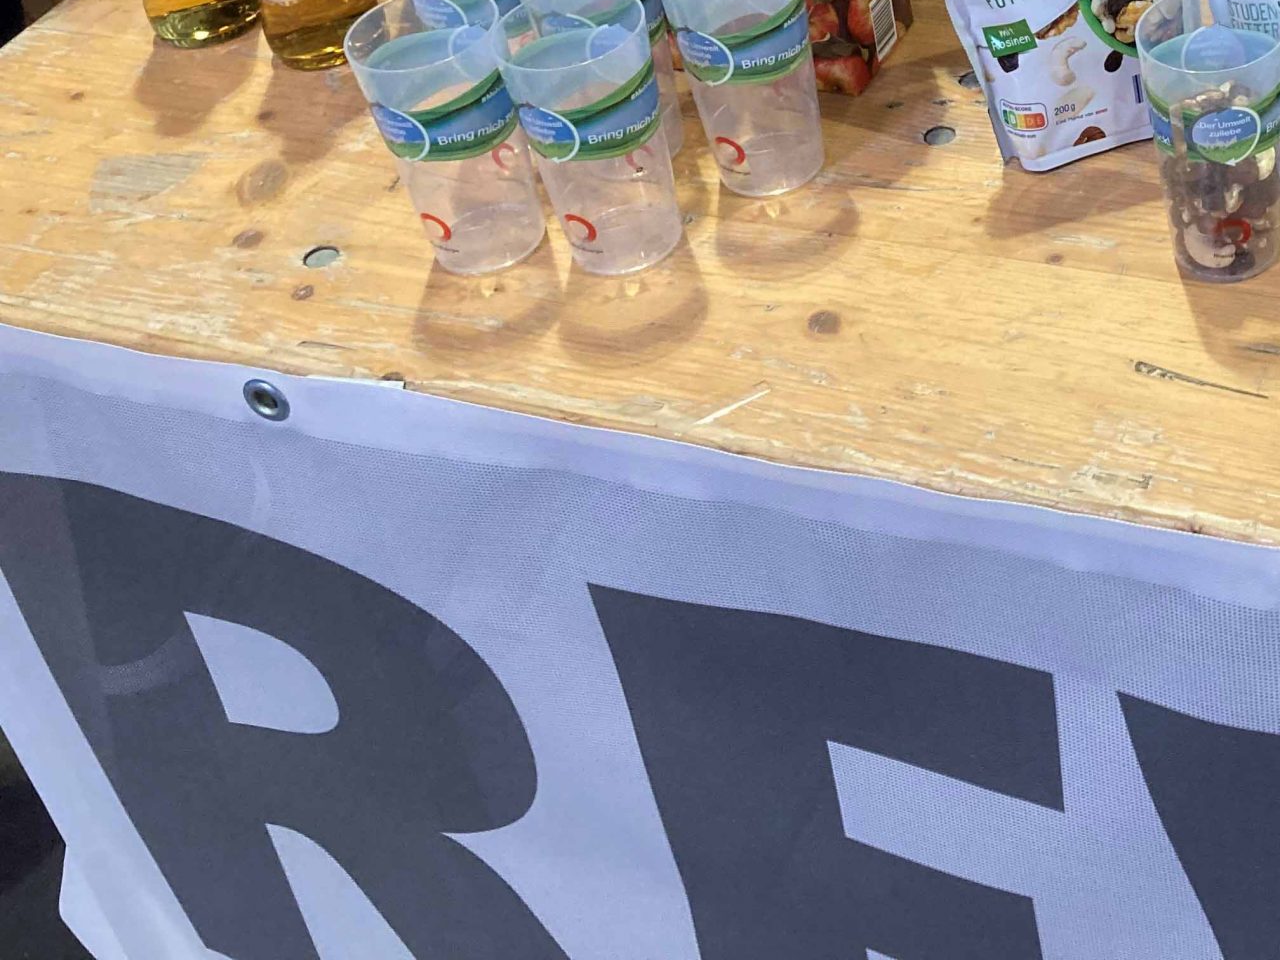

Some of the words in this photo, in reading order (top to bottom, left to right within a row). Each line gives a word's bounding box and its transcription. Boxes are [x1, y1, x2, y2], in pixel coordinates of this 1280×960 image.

[741, 54, 776, 71] Bring
[777, 45, 800, 63] mich
[1054, 104, 1070, 117] 200
[1071, 105, 1076, 113] g
[437, 128, 475, 146] Bring
[477, 119, 505, 137] mich
[587, 126, 625, 145] Bring
[626, 117, 652, 135] mich
[1199, 119, 1216, 130] Der
[1217, 115, 1251, 130] Umwelt
[1209, 127, 1242, 138] zuliebe
